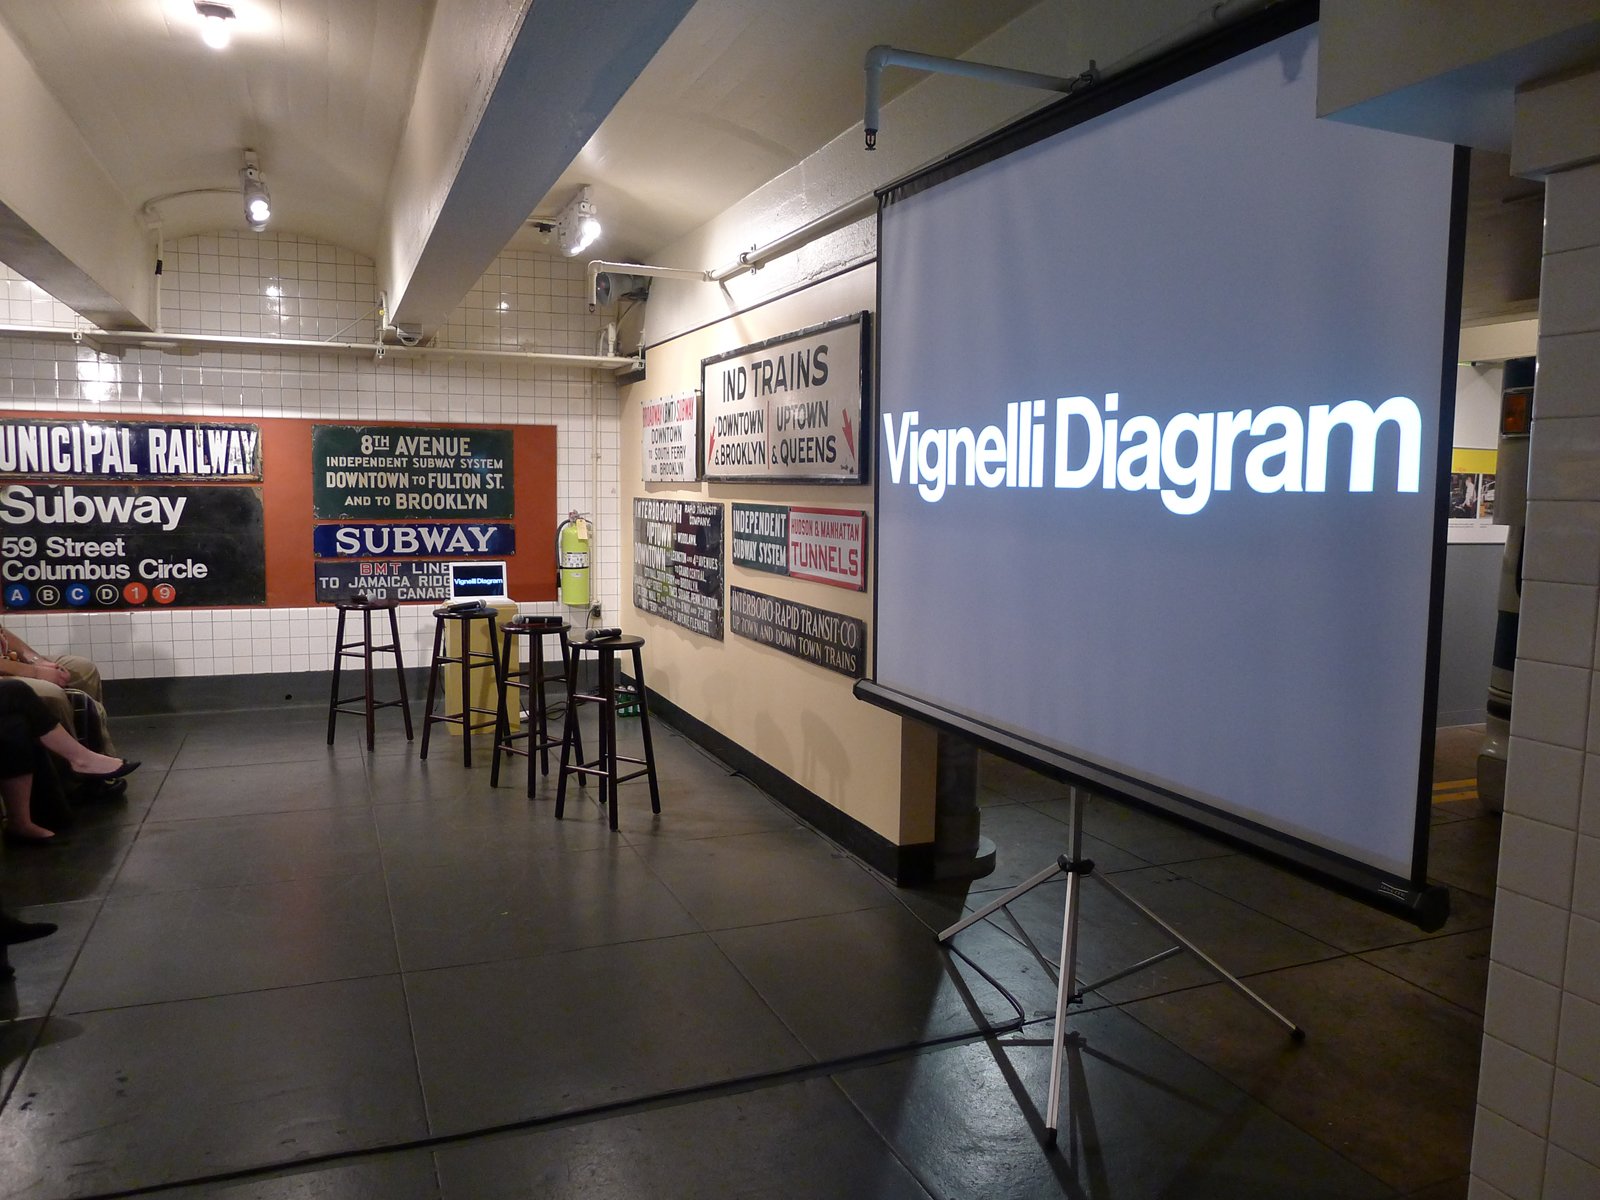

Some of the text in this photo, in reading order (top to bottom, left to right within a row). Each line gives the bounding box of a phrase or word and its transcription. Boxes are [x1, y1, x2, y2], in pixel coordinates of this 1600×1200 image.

[723, 344, 828, 402] IND TRAINS
[718, 410, 764, 437] DOWNTOWN
[776, 401, 828, 432] UPTOWN
[361, 434, 472, 456] 8TH AVENUE
[652, 425, 682, 444] DOWNTOWN
[149, 428, 257, 474] RAILWAY
[326, 456, 503, 468] INDEPENDENT SUBWAY SYSTEM
[655, 447, 670, 460] SOUTH
[671, 446, 686, 460] FERRY
[720, 440, 766, 466] BROOKLYN
[772, 435, 836, 466] & QUEENS
[883, 392, 1423, 516] Vignelli Diagram
[326, 472, 504, 490] DOWNTOWN TO FULTON ST.
[660, 462, 684, 475] BROOKLYN
[0, 484, 187, 531] Subway
[344, 494, 488, 510] AND TO BROOKLYN
[636, 501, 682, 524] INTERBOROUGH
[697, 505, 717, 516] TRANSIT
[647, 522, 672, 548] UPTOWN
[733, 510, 786, 538] INDEPENDENT
[791, 518, 859, 542] HUDSON & MANHATTAN
[1, 536, 126, 558] 59 Street
[336, 526, 498, 554] SUBWAY
[734, 538, 786, 567] SUBWAY SYSTEM
[2, 558, 208, 581] Columbus Circle
[360, 562, 401, 576] BMT
[635, 542, 666, 571] DOWNTOWN
[791, 541, 858, 576] TUNNELS
[11, 588, 170, 601] A B C D 1 9
[320, 577, 340, 588] TO
[348, 576, 410, 588] JAMAICA
[775, 602, 800, 630] RAPID
[800, 609, 839, 643] TRANSIT
[732, 615, 856, 672] UP TOWN AND DOWN TOWN TRAINS
